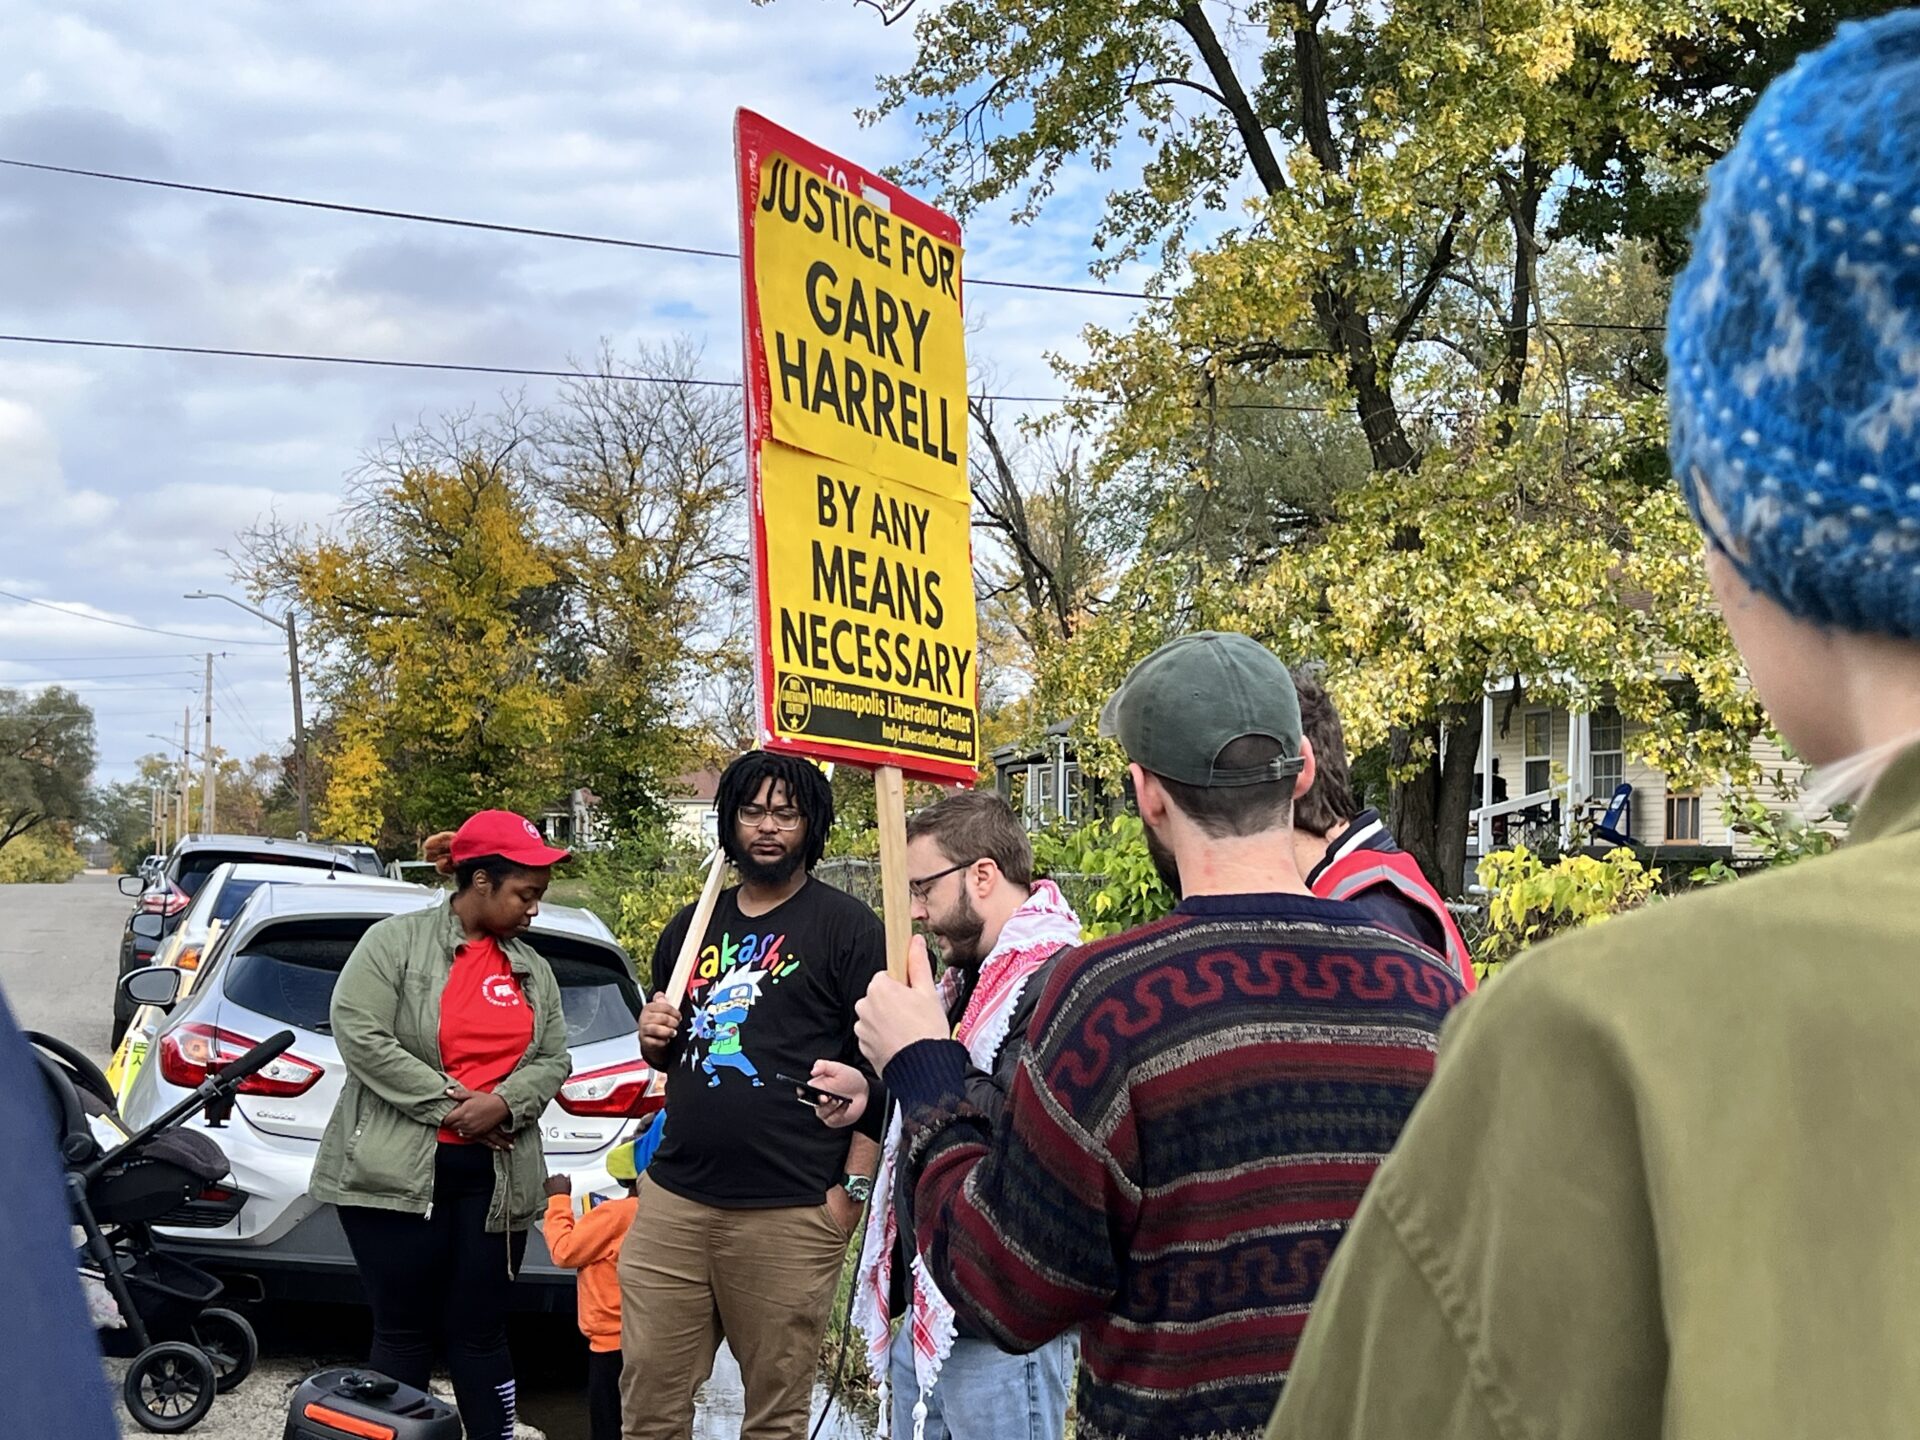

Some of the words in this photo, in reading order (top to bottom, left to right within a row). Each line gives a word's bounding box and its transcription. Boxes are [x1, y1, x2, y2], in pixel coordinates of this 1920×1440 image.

[761, 158, 891, 268] JUSTICE
[901, 226, 957, 302] FOR
[806, 260, 931, 374] GARY
[775, 330, 958, 466] HARRELL
[816, 474, 861, 534] BY
[870, 492, 930, 555] ANY
[811, 539, 944, 630] MEANS
[780, 607, 972, 699] NECESSARY
[811, 681, 886, 719] Indianapolis
[887, 694, 939, 728] Liberation
[941, 706, 971, 734] Center
[882, 720, 973, 758] IndyLiberationCenter.org
